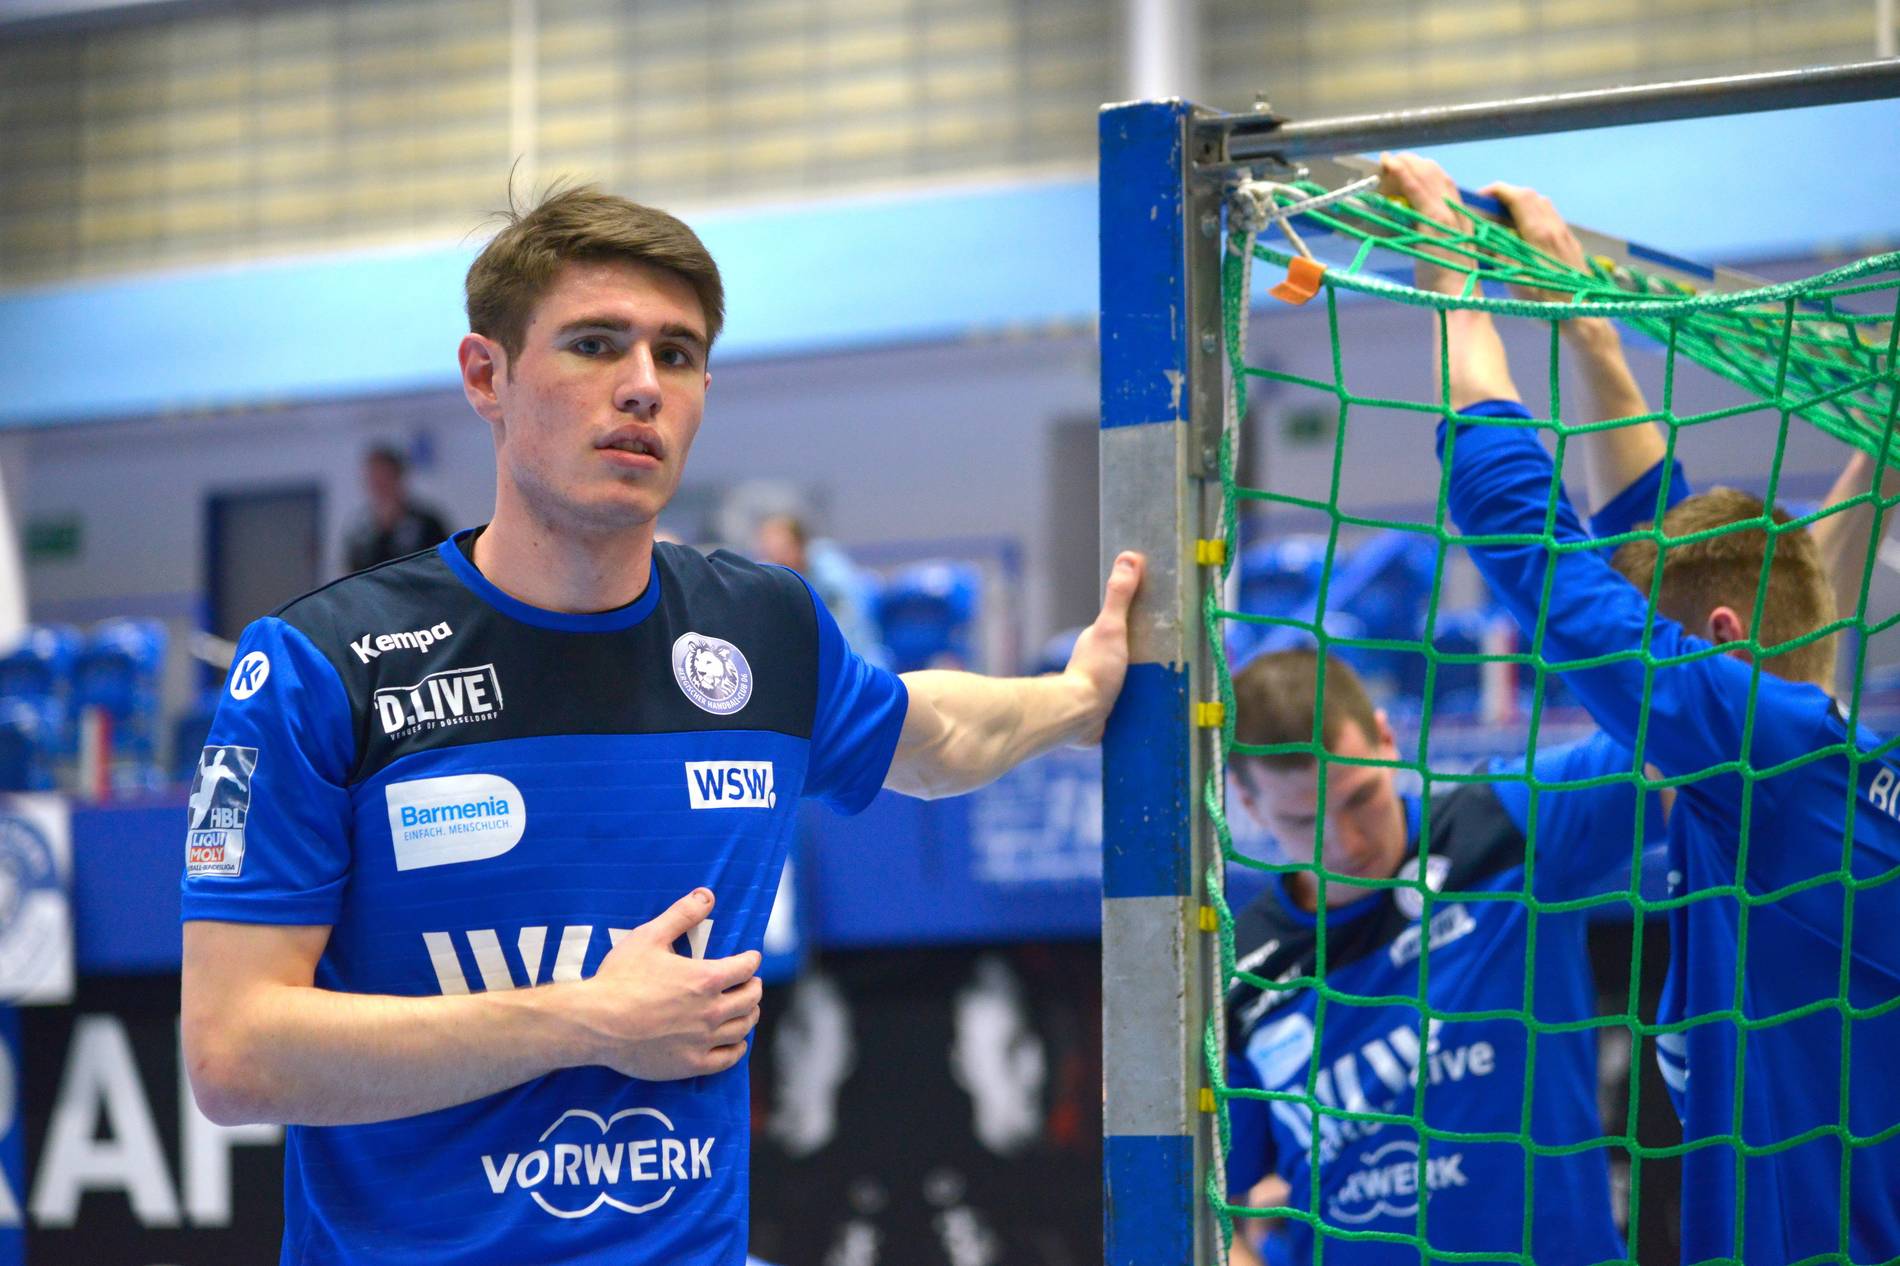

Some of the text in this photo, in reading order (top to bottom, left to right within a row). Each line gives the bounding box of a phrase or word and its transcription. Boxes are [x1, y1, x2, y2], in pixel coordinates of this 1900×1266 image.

[351, 621, 452, 664] Kempa
[377, 673, 493, 734] D.LIVE
[210, 807, 244, 828] HBL
[400, 796, 510, 827] Barmenia
[192, 833, 226, 846] LIQUI
[404, 819, 512, 841] EINFACH. MENSCHLICH.
[190, 847, 224, 861] MOLY
[481, 1137, 715, 1193] VORWERK
